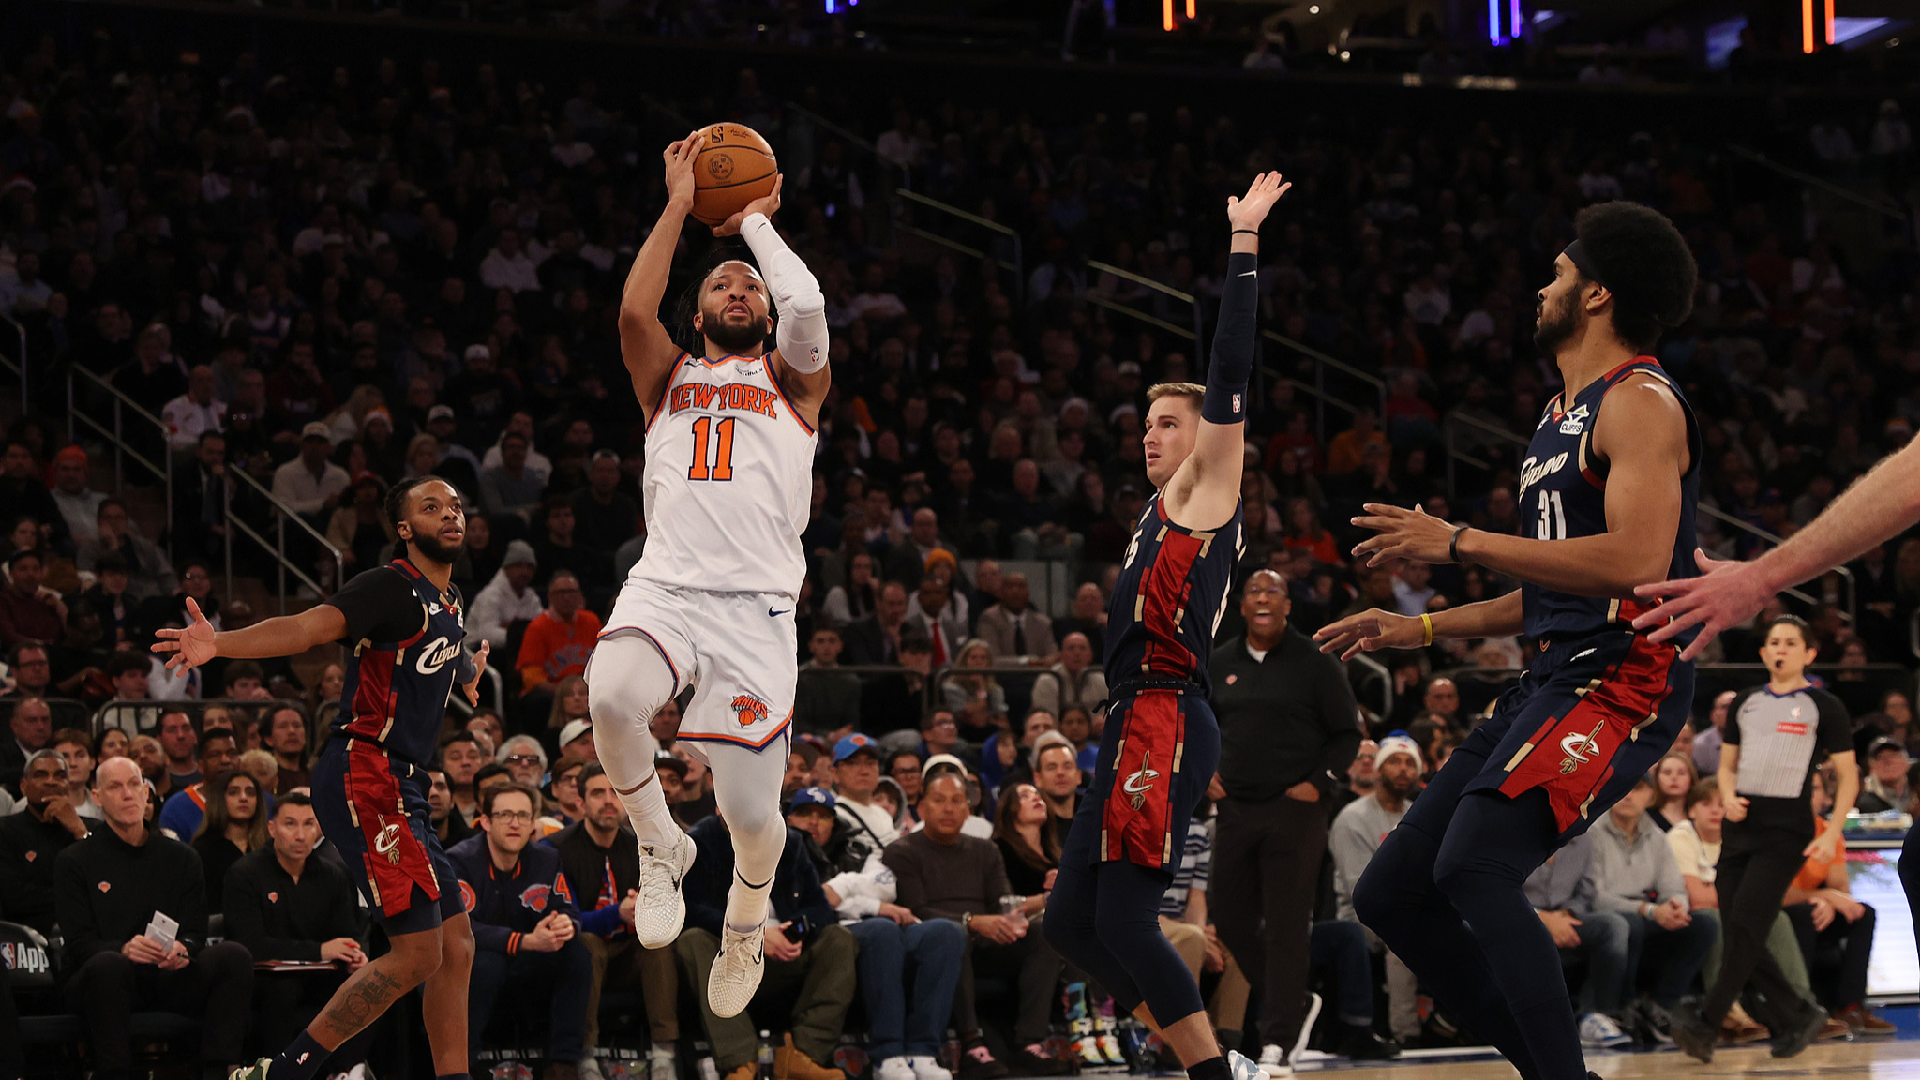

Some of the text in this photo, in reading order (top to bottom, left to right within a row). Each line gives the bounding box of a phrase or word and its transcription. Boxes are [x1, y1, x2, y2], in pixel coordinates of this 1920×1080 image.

[669, 383, 777, 419] NEW YORK
[1561, 423, 1582, 432] CLIFFS
[687, 416, 736, 481] 11
[1537, 488, 1567, 540] 31
[17, 942, 50, 974] App
